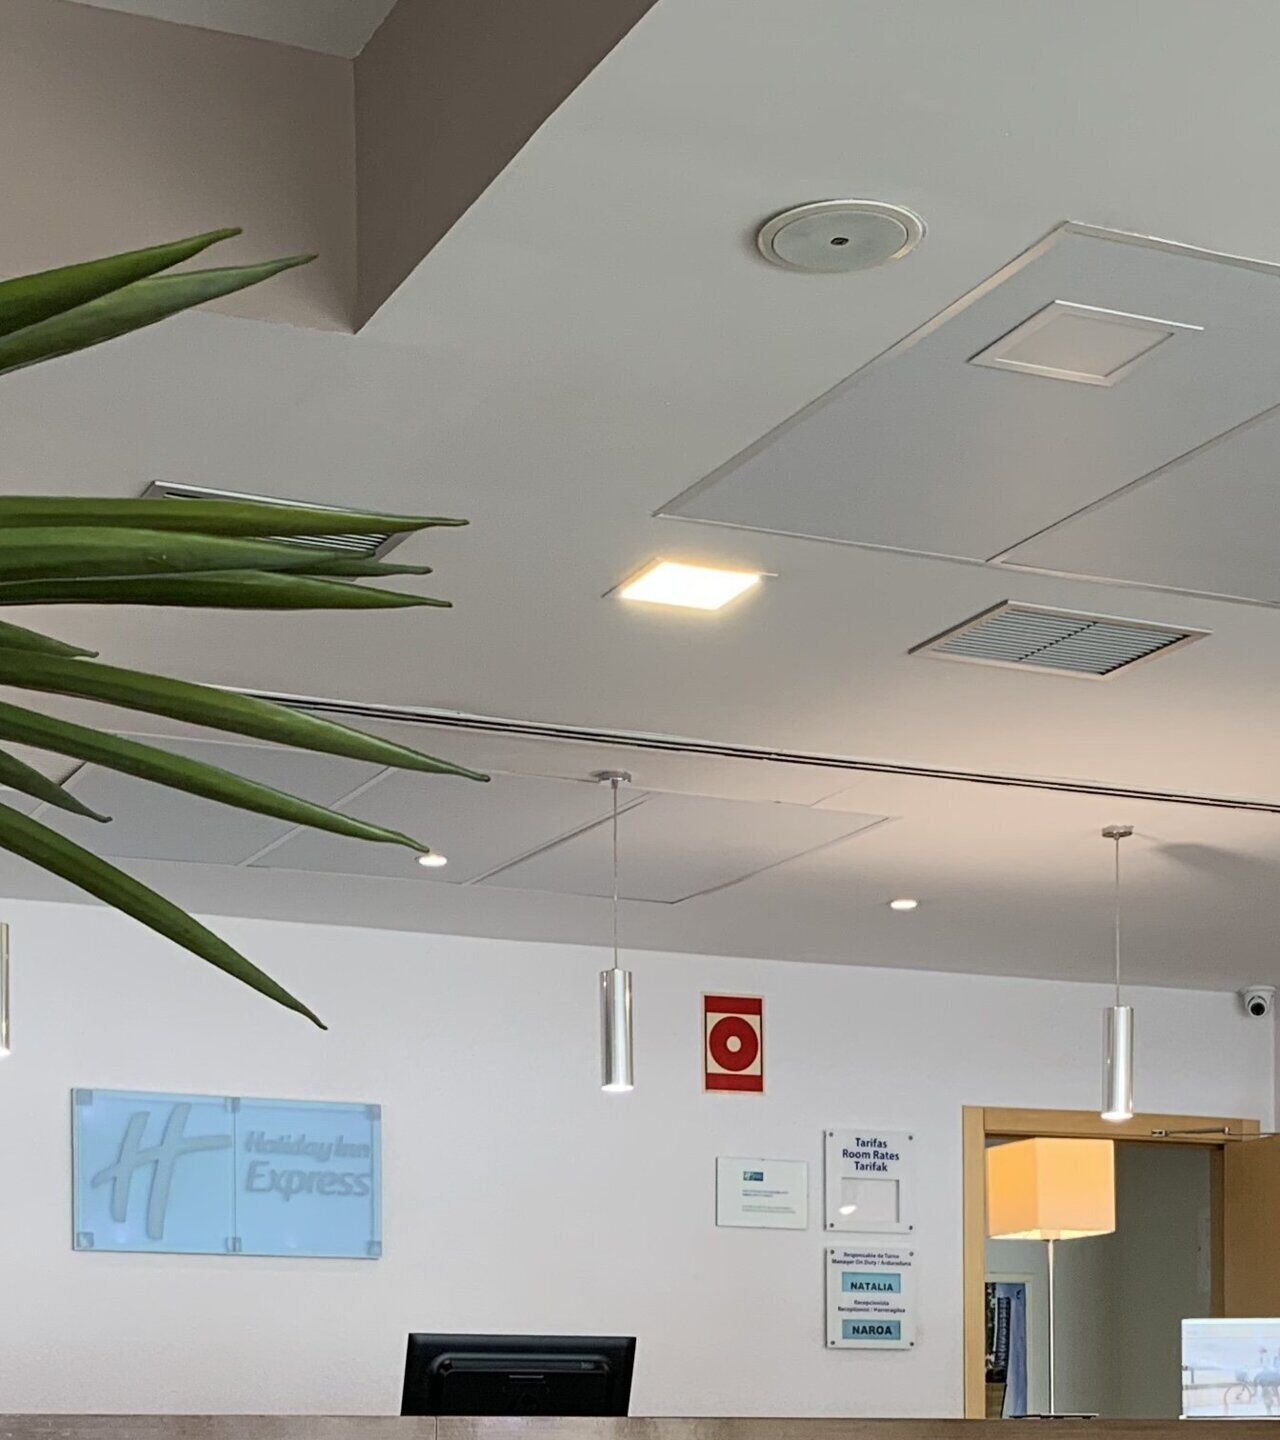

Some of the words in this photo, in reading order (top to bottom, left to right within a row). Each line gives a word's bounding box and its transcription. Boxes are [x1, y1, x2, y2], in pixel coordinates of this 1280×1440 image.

[245, 1130, 334, 1162] Holiday
[334, 1134, 370, 1159] Inn
[855, 1137, 888, 1149] Tarifas
[842, 1148, 871, 1159] Room
[872, 1150, 900, 1161] Rates
[854, 1161, 888, 1172] Tarifak
[244, 1159, 371, 1202] Express
[850, 1281, 894, 1292] NATALIA
[852, 1325, 893, 1336] NAROA
